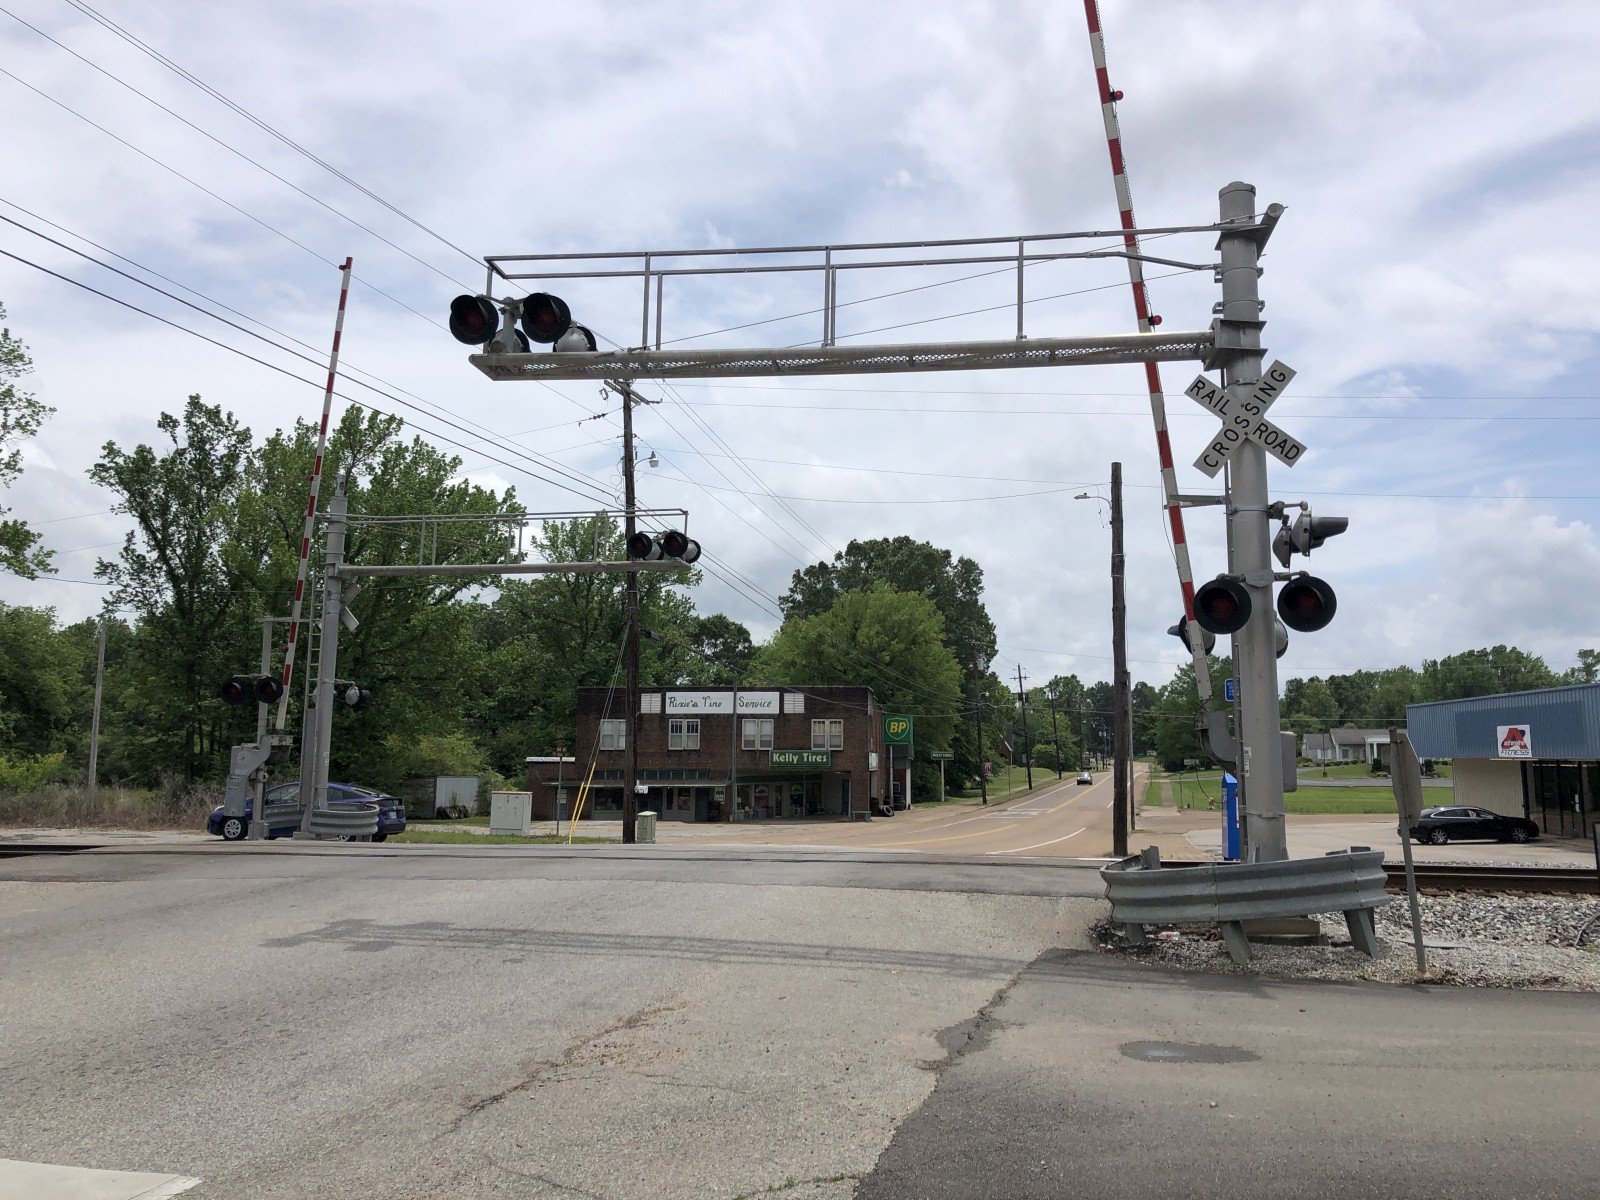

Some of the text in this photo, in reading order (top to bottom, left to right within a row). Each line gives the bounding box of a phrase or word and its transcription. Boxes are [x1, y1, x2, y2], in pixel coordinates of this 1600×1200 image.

[1190, 380, 1300, 461] RAIL ROAD
[1203, 369, 1286, 468] CROSSING
[702, 696, 722, 708] Tire
[738, 696, 772, 708] Service
[889, 721, 907, 733] BP
[773, 752, 827, 764] Kelly Tires
